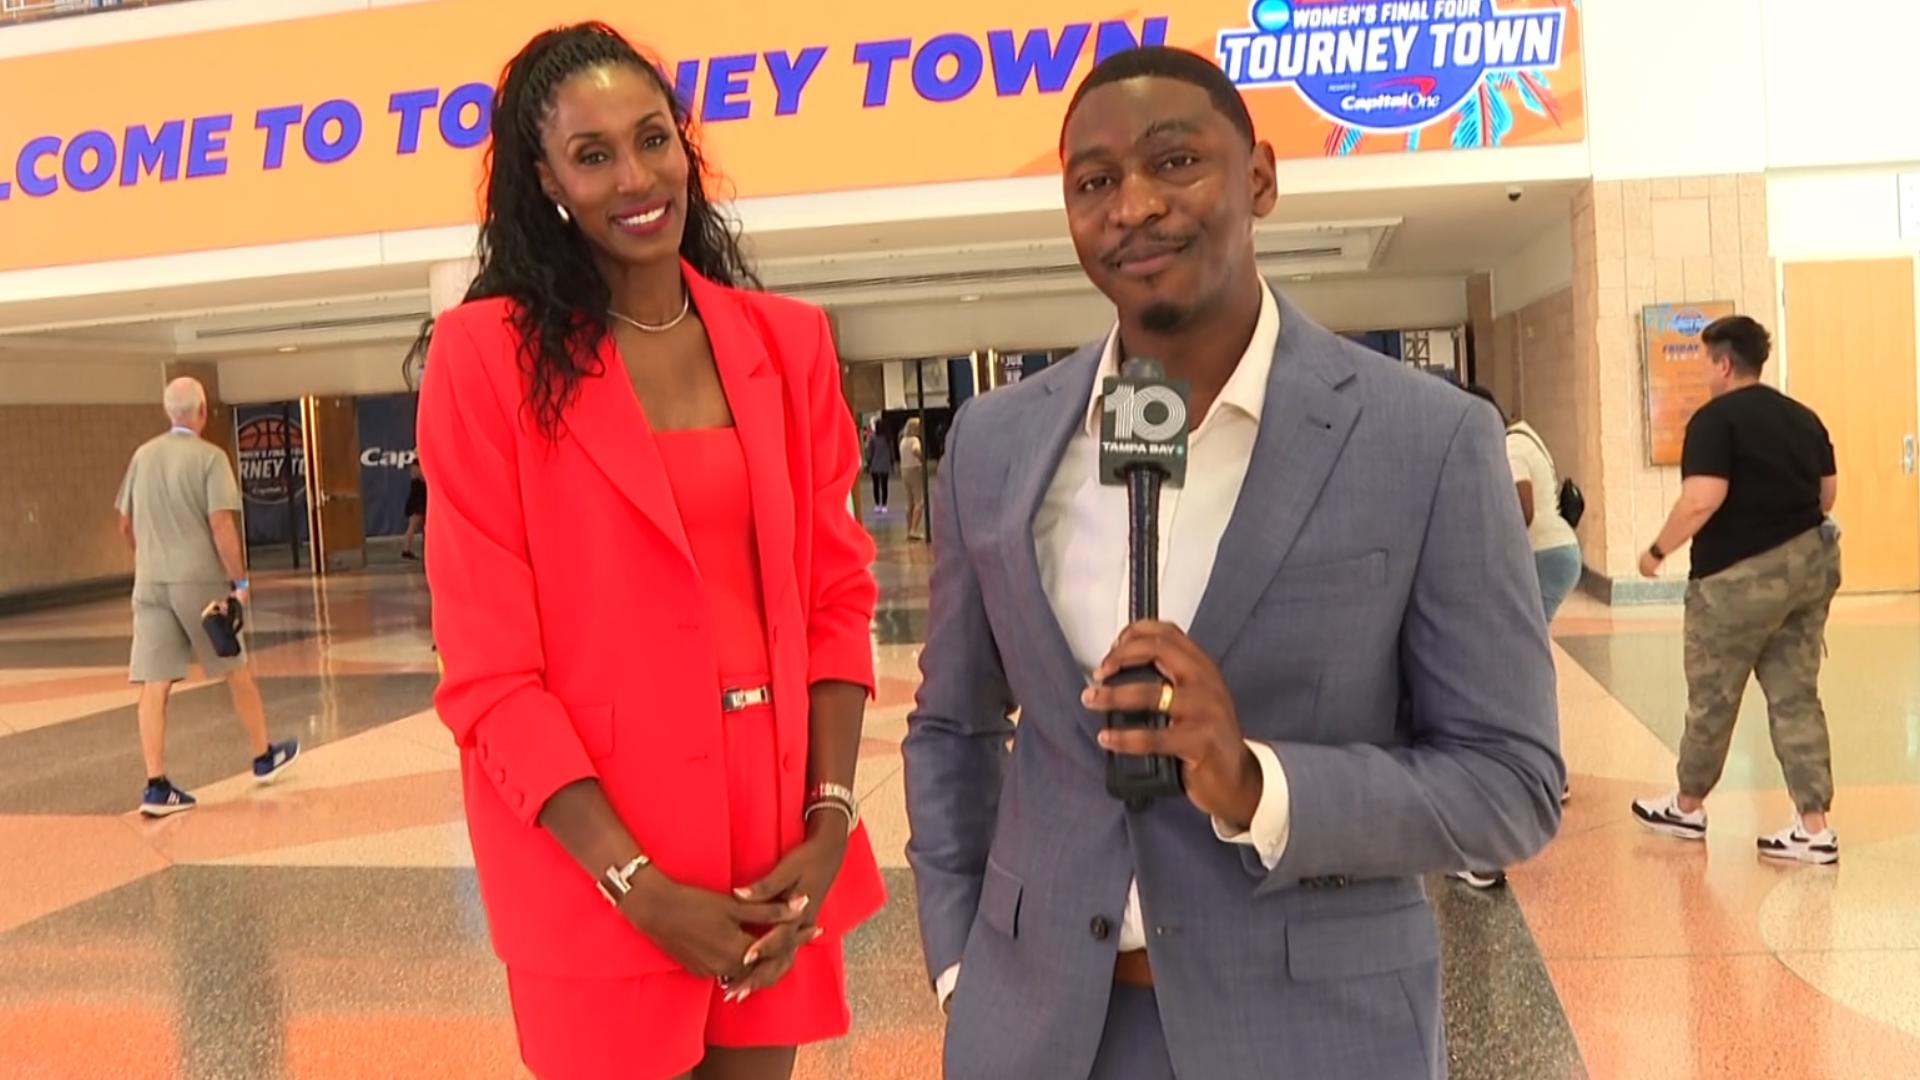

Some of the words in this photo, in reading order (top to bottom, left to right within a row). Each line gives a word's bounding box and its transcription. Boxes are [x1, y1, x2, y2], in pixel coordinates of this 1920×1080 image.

[1293, 4, 1378, 30] WOMEN'S
[1380, 1, 1430, 23] FINAL
[1433, 0, 1482, 20] FOUR
[1224, 25, 1422, 81] TOURNEY
[1429, 15, 1555, 68] TOWN
[0, 113, 232, 200] COME
[255, 100, 363, 169] TO
[1103, 383, 1187, 442] 10
[360, 447, 417, 469] Cap
[1102, 441, 1147, 454] TAMPA
[1148, 443, 1175, 455] BAY
[240, 458, 285, 479] RNEY
